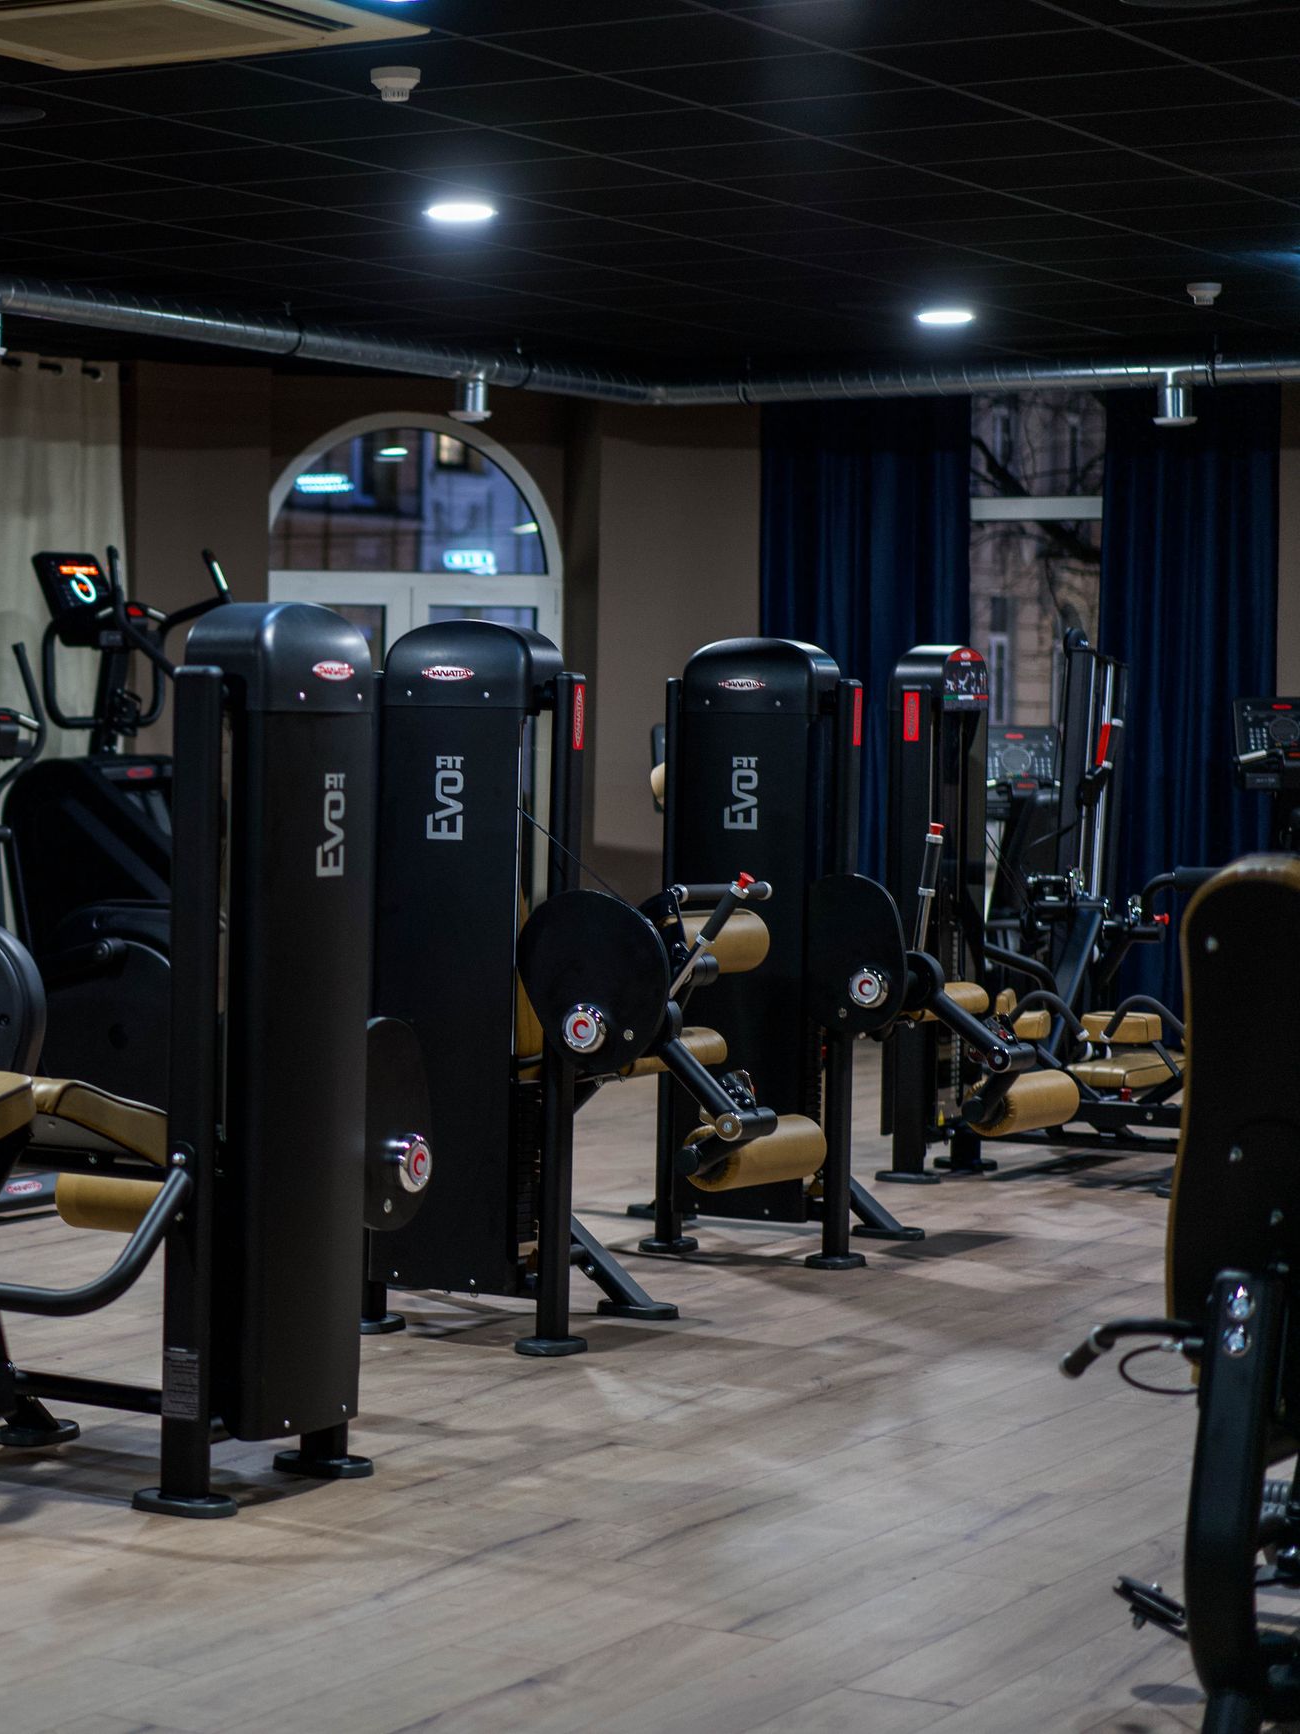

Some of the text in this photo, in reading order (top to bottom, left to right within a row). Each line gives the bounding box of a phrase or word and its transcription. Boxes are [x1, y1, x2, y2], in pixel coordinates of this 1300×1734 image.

[325, 773, 345, 789] FIT
[436, 756, 464, 769] FIT
[732, 757, 758, 768] FIT
[426, 770, 464, 840] EVO
[724, 769, 758, 830] EVO
[316, 791, 345, 877] EVO
